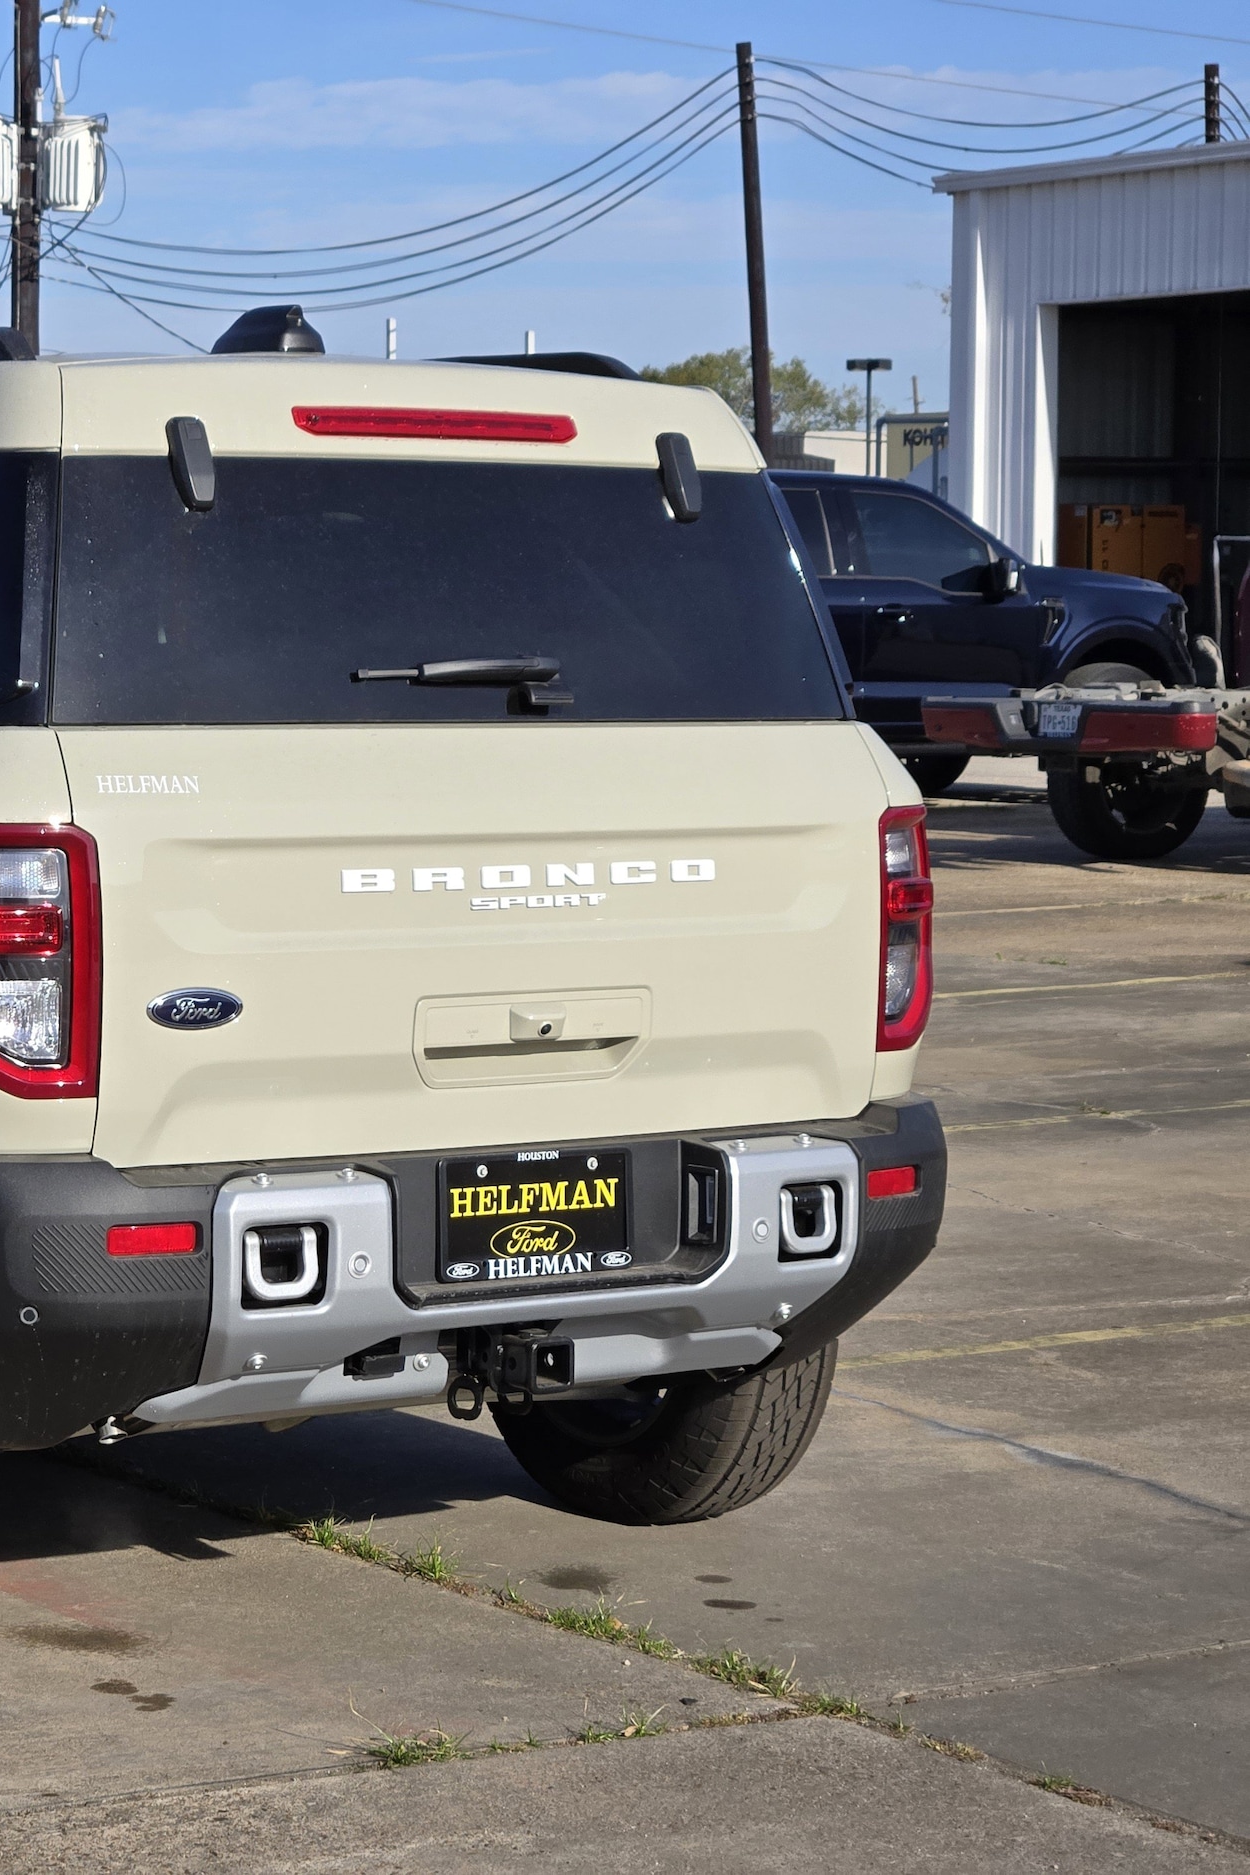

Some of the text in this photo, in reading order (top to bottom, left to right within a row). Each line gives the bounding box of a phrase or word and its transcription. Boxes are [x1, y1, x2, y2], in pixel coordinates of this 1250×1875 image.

[95, 774, 201, 795] HELFMAN
[340, 858, 717, 894] BRONCO
[469, 892, 607, 912] SPORT
[171, 997, 223, 1021] Ford
[517, 1150, 559, 1162] HOUSTON
[450, 1178, 619, 1218] HELFMAN
[506, 1225, 559, 1254] Ford
[488, 1252, 593, 1279] HELFMAN
